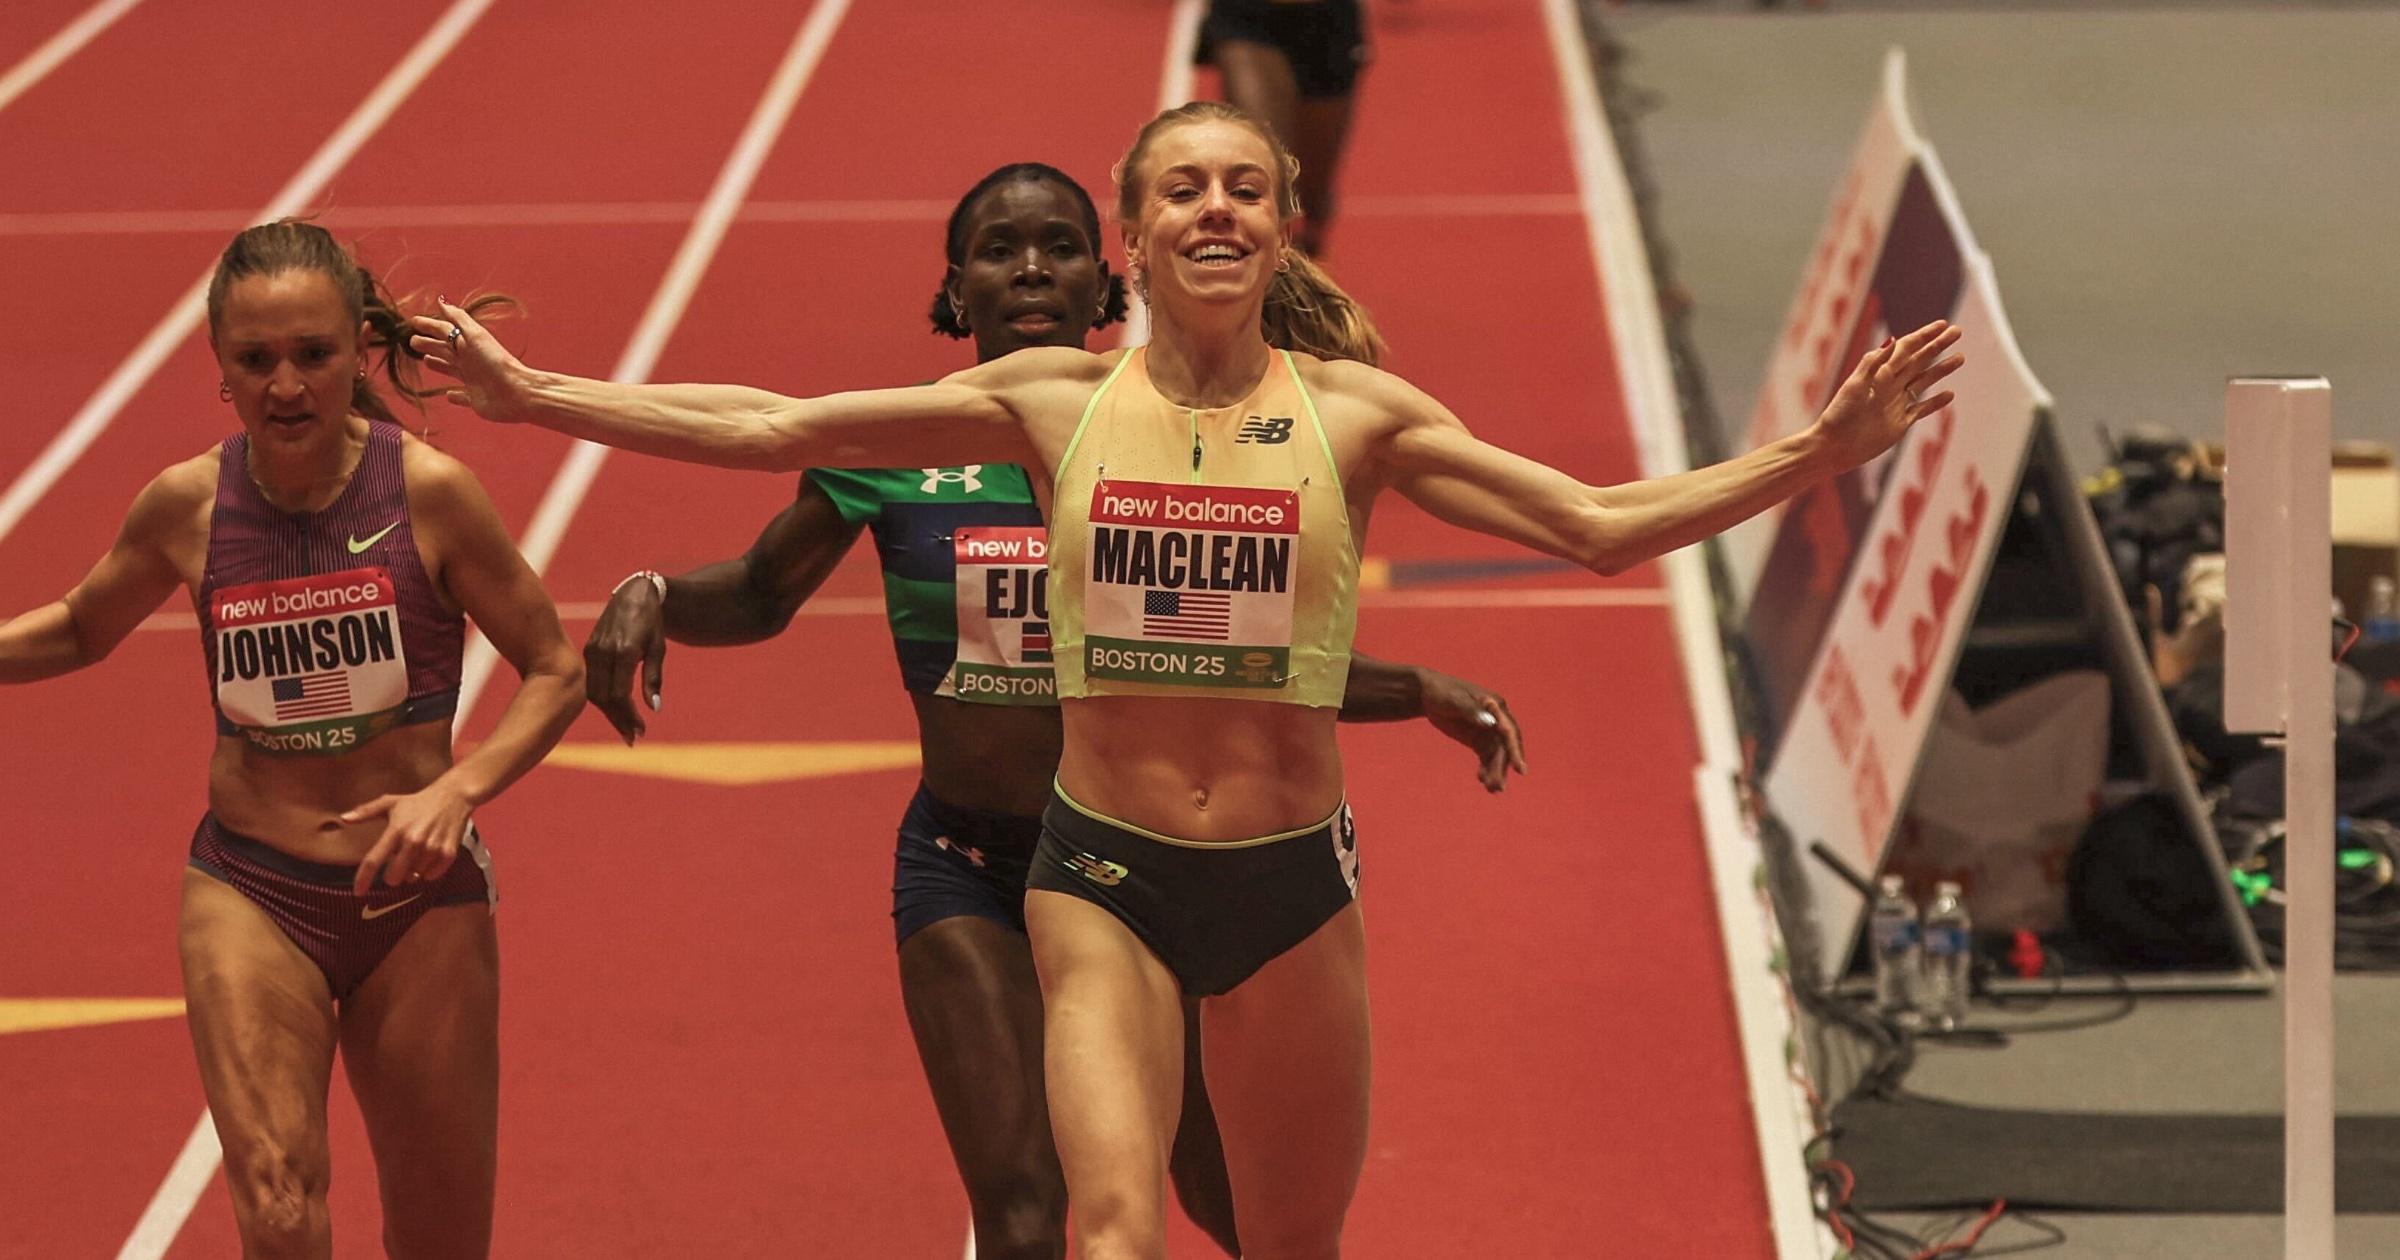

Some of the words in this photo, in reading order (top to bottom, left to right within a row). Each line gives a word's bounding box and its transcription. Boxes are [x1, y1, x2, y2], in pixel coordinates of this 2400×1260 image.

[1103, 496, 1158, 517] new
[1164, 495, 1284, 525] balance
[968, 540, 1021, 557] new
[1093, 527, 1290, 593] MACLEAN
[221, 598, 266, 621] new
[272, 583, 379, 614] balance
[986, 568, 1048, 619] EJO
[222, 610, 395, 682] JOHNSON
[1092, 648, 1187, 674] BOSTON
[1194, 656, 1226, 676] 25
[963, 673, 1054, 695] BOSTON
[327, 727, 357, 747] 25
